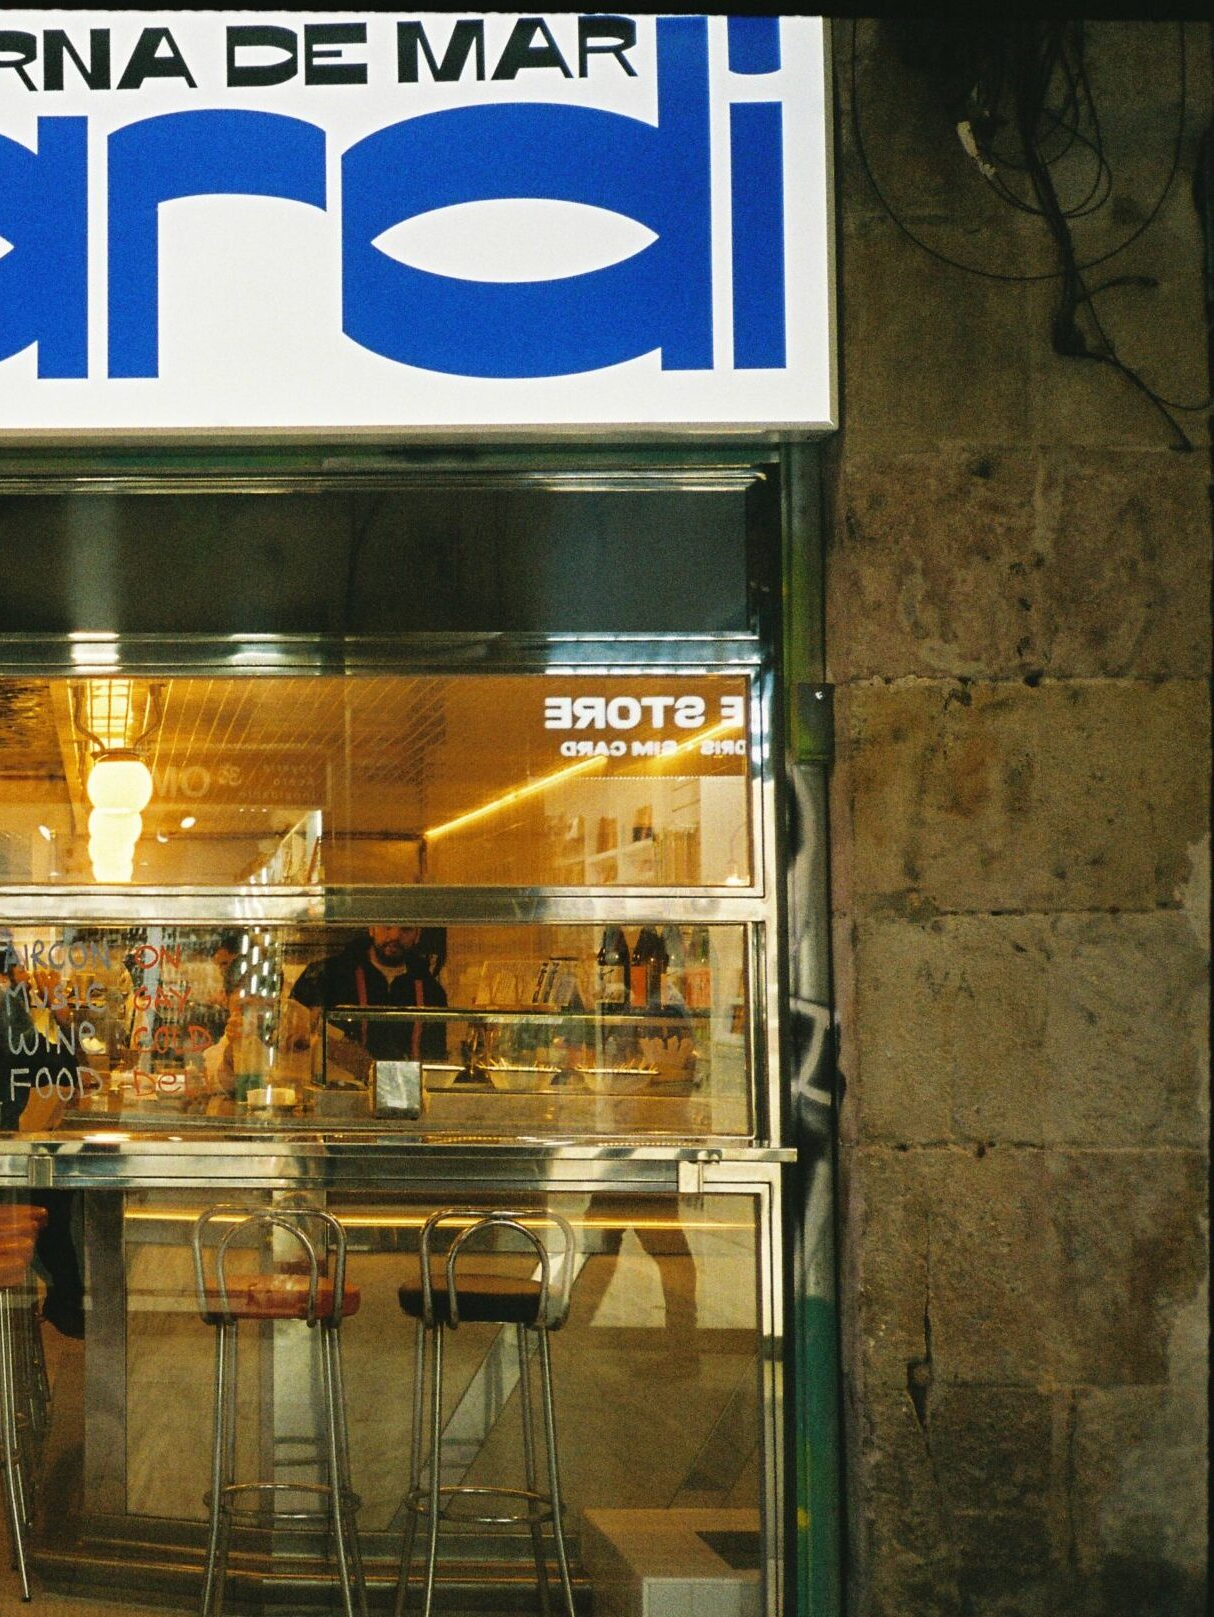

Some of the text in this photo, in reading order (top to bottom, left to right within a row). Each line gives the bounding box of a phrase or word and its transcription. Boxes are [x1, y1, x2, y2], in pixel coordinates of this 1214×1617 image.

[226, 22, 368, 87] DE
[396, 15, 638, 83] MAR
[4, 940, 181, 973] AIRCON ON
[6, 981, 192, 1016] MUSIC GAY
[133, 1025, 212, 1055] COLD
[11, 1066, 103, 1102] FOOD
